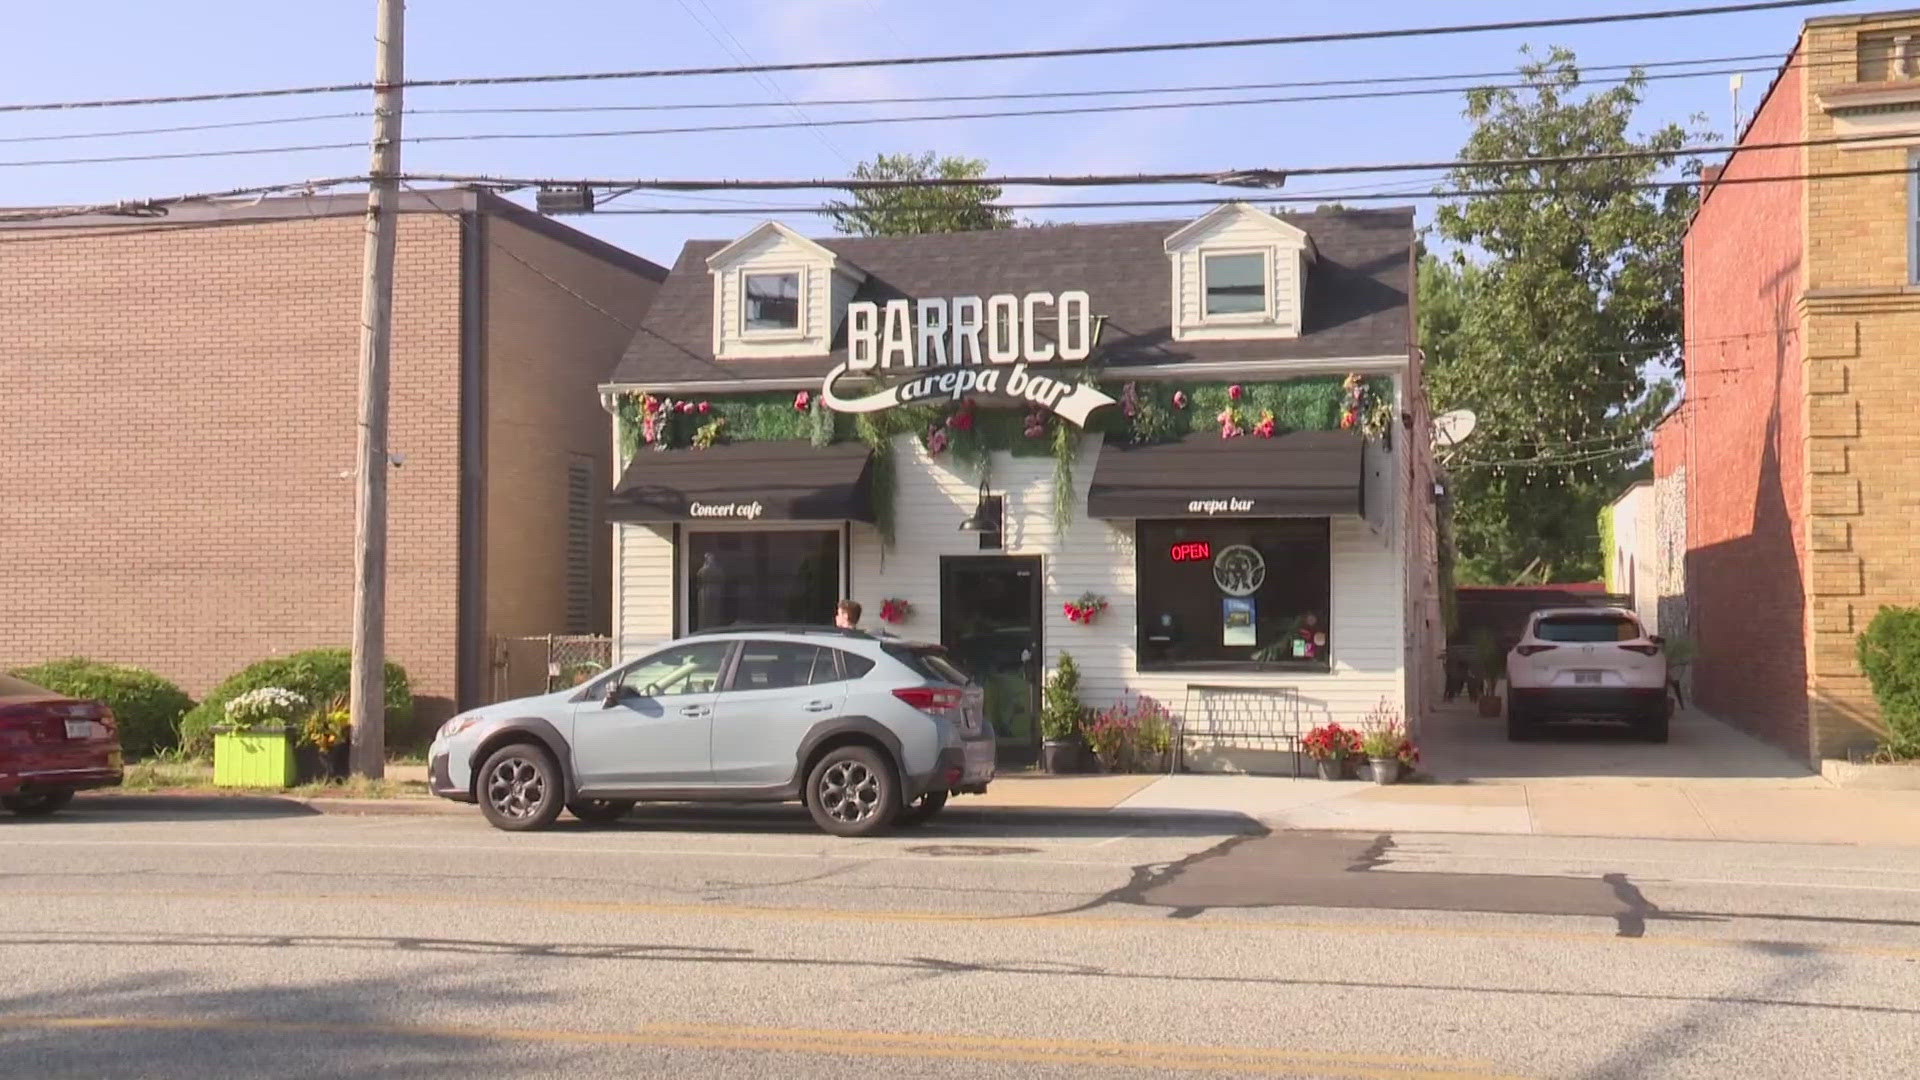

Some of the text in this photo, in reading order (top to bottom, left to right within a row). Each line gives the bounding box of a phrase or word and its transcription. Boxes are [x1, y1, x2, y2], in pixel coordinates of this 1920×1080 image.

[848, 291, 1090, 369] BARROCO
[901, 363, 1072, 406] arepa bar
[690, 501, 762, 520] Concert cafe
[1188, 496, 1254, 515] arepa bar
[1171, 542, 1209, 560] OPEN
